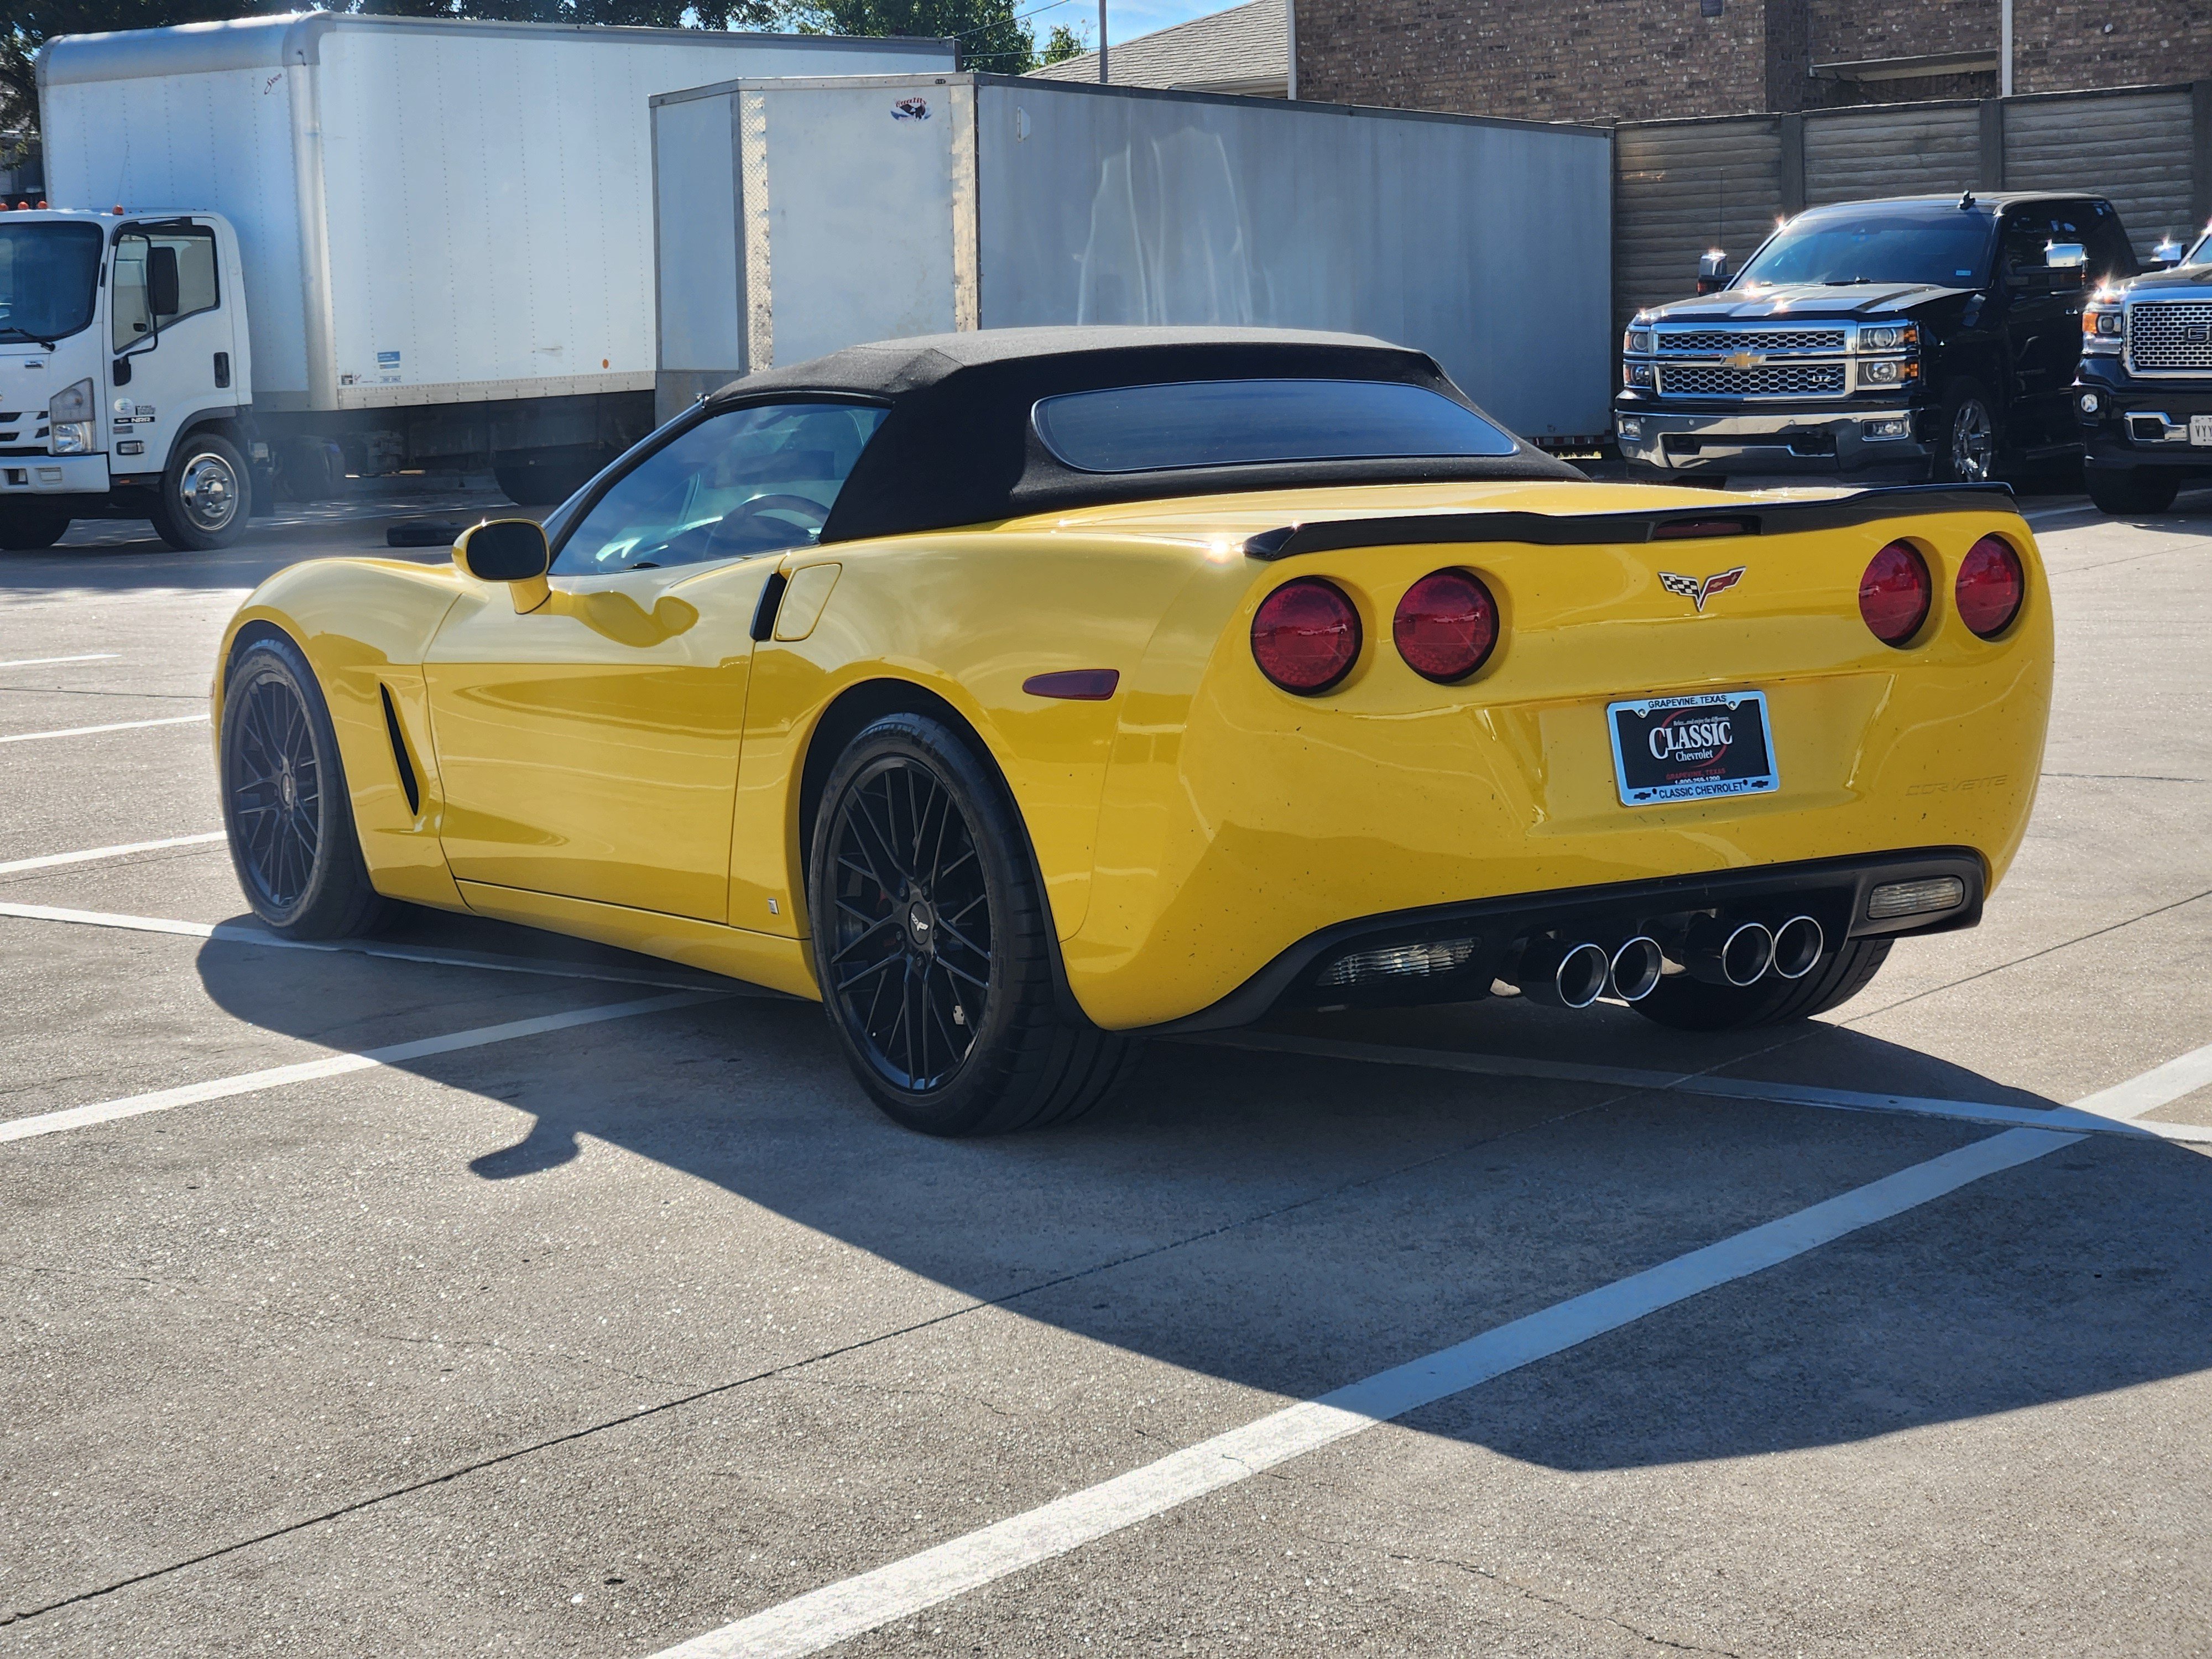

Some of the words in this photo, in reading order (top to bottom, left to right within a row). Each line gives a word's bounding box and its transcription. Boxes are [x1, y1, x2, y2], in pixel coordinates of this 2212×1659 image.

[1648, 697, 1698, 708] GRAPEVINE,
[1699, 695, 1726, 705] TEXAS
[1648, 721, 1733, 760] CLASSIC
[1675, 748, 1714, 762] Chevrolet
[1659, 787, 1693, 799] CLASSIC
[1695, 782, 1743, 795] CHEVROLET
